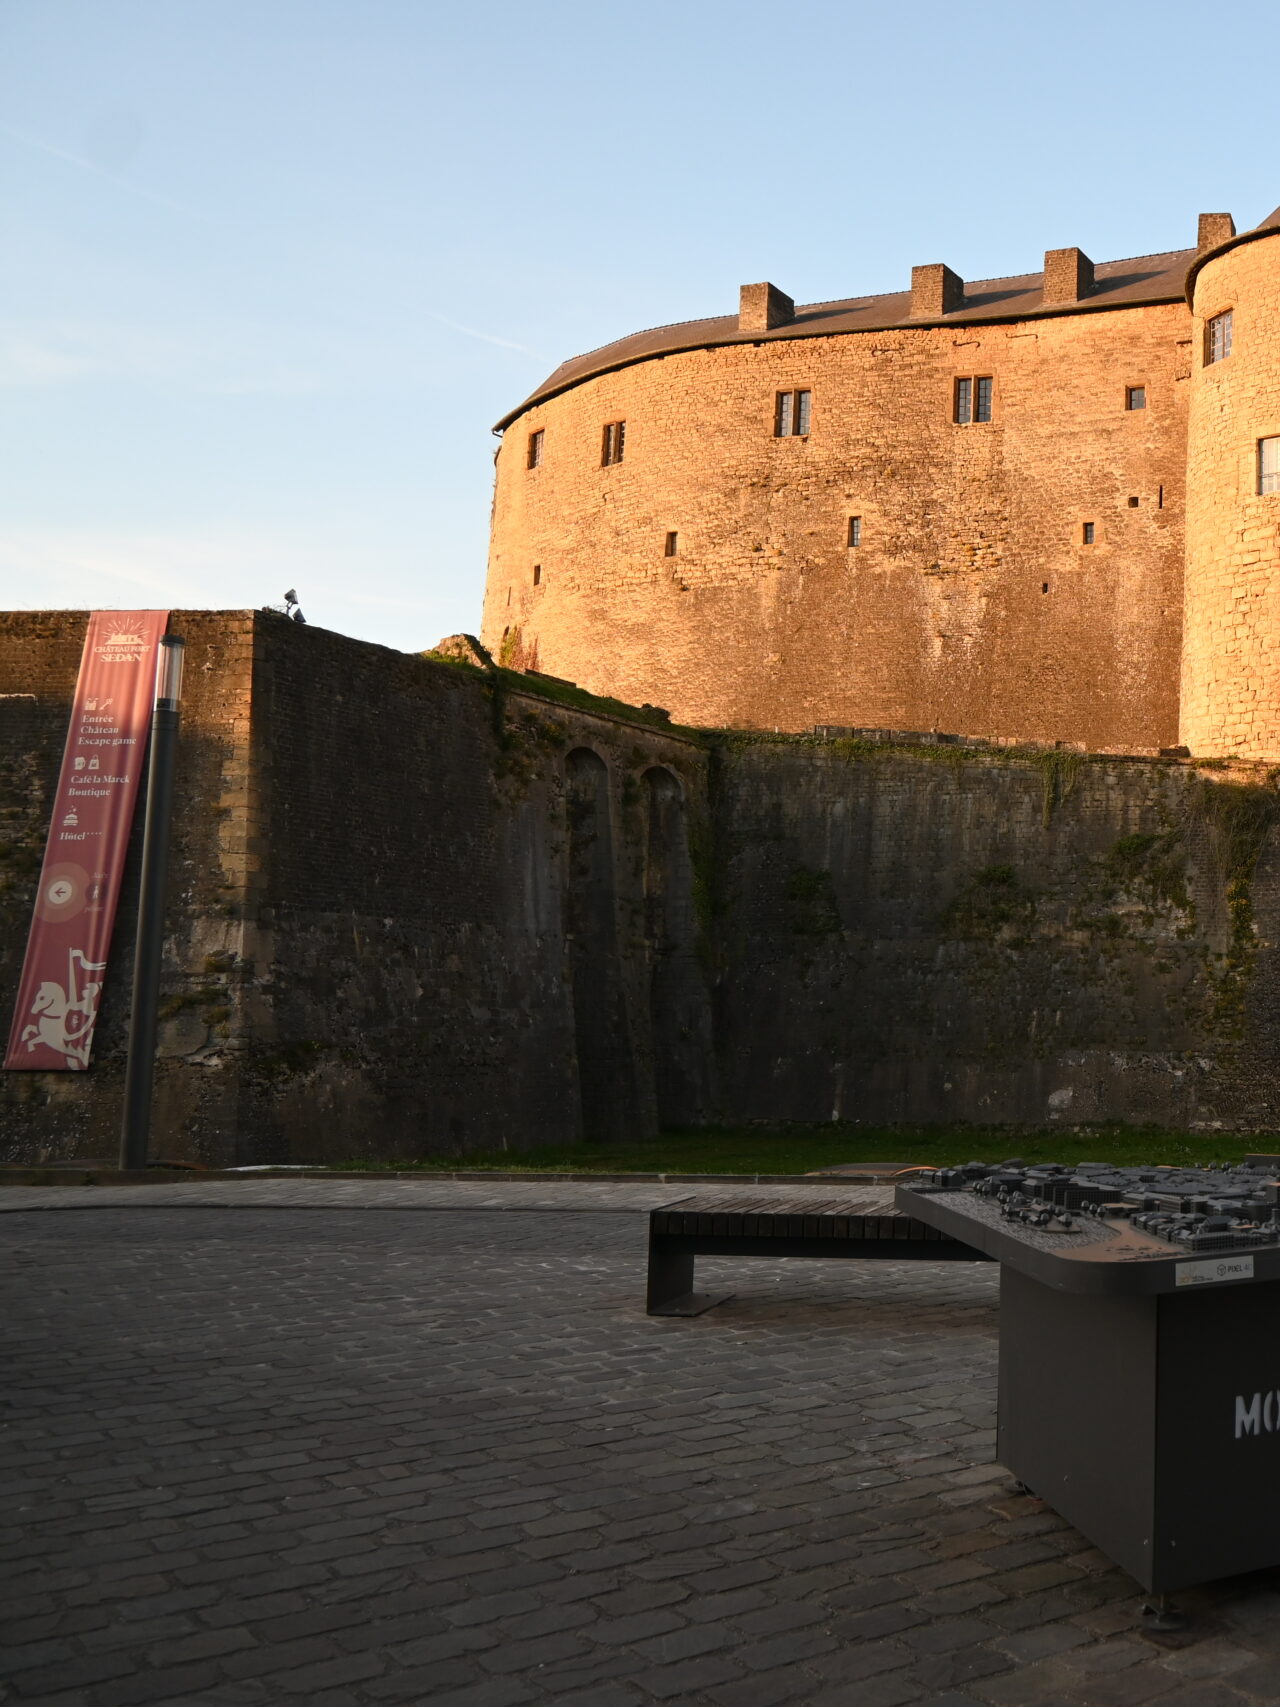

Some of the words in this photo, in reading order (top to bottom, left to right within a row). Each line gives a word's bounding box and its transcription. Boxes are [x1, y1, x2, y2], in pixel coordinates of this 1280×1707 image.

[101, 653, 142, 662] SEDAN
[82, 715, 114, 723] Entrée
[80, 725, 119, 734] Château
[78, 737, 111, 746] Escape
[112, 738, 137, 746] game
[71, 775, 92, 784] Café
[93, 775, 101, 784] la
[102, 775, 130, 784] Marck
[68, 788, 111, 797] Boutique
